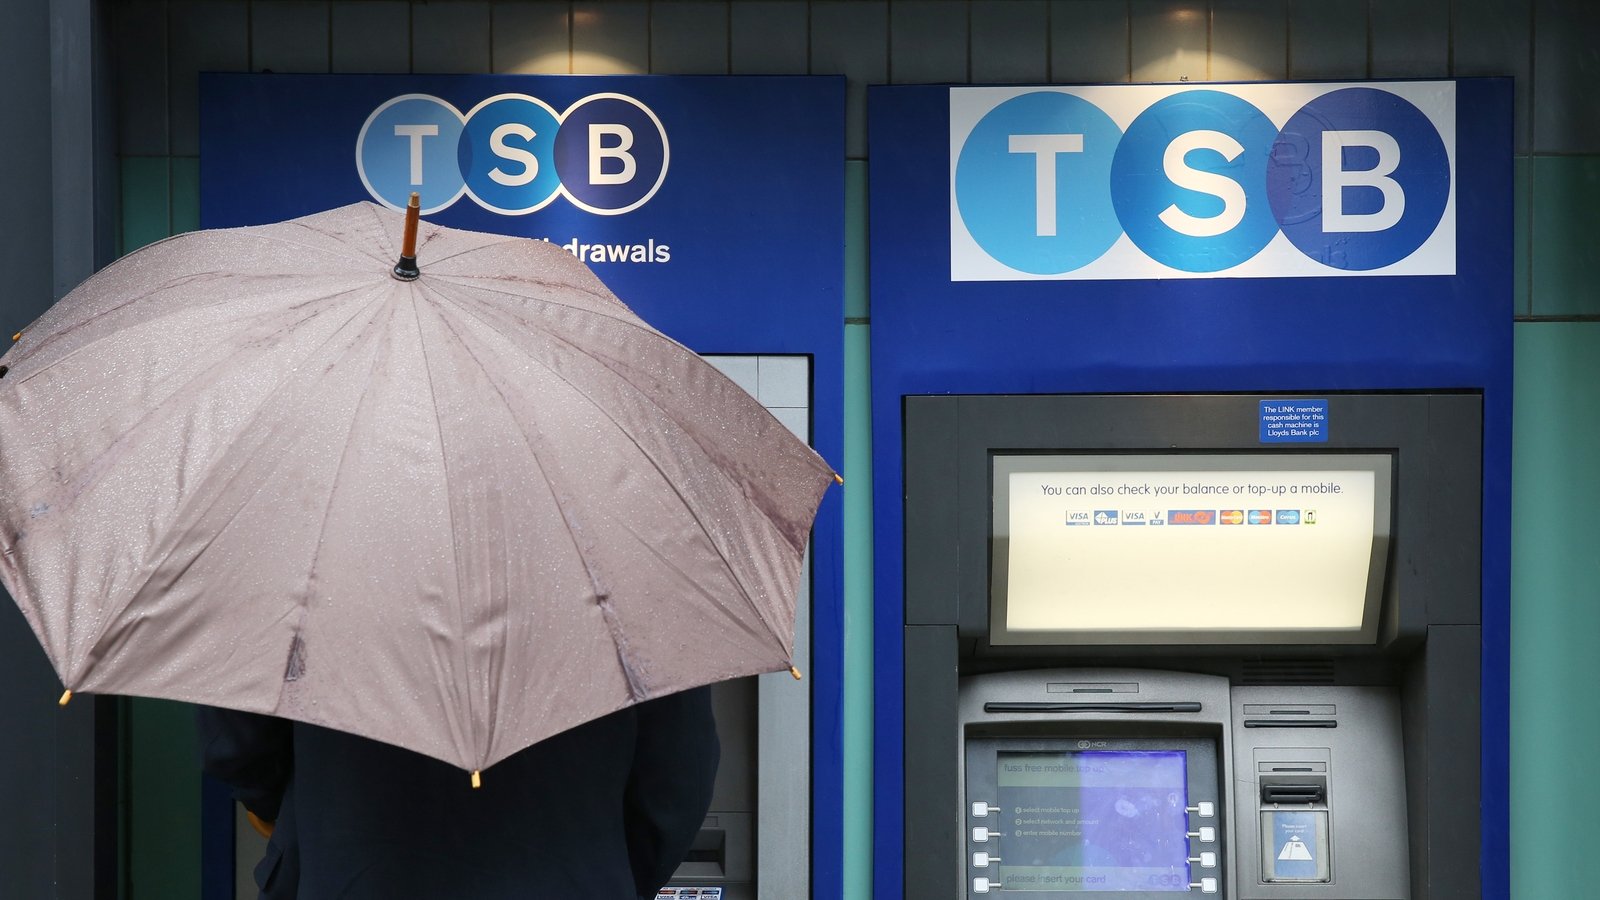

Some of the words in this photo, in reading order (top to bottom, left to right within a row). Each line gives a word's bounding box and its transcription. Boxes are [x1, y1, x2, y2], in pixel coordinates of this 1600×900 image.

[394, 123, 637, 187] TSB
[1008, 129, 1406, 238] TSB
[527, 237, 671, 263] drawals
[1267, 429, 1289, 437] Lloyds
[1309, 429, 1320, 437] plc
[1041, 484, 1062, 495] You
[1065, 486, 1087, 495] can
[1090, 484, 1114, 495] also
[1117, 483, 1151, 495] check
[1154, 486, 1180, 497] your
[1183, 483, 1230, 495] balance
[1232, 485, 1245, 494] or
[1248, 483, 1287, 497] top-up
[1290, 485, 1298, 494] a
[1301, 482, 1344, 494] mobile.
[1070, 512, 1089, 520] VISA
[1125, 512, 1144, 520] VISA
[1004, 763, 1023, 772] fuss
[1025, 763, 1042, 772] free
[1044, 763, 1074, 772] mobile
[1060, 807, 1070, 815] top
[1007, 875, 1035, 885] please
[1038, 874, 1062, 883] insert
[1064, 876, 1084, 886] your
[1086, 874, 1106, 883] card
